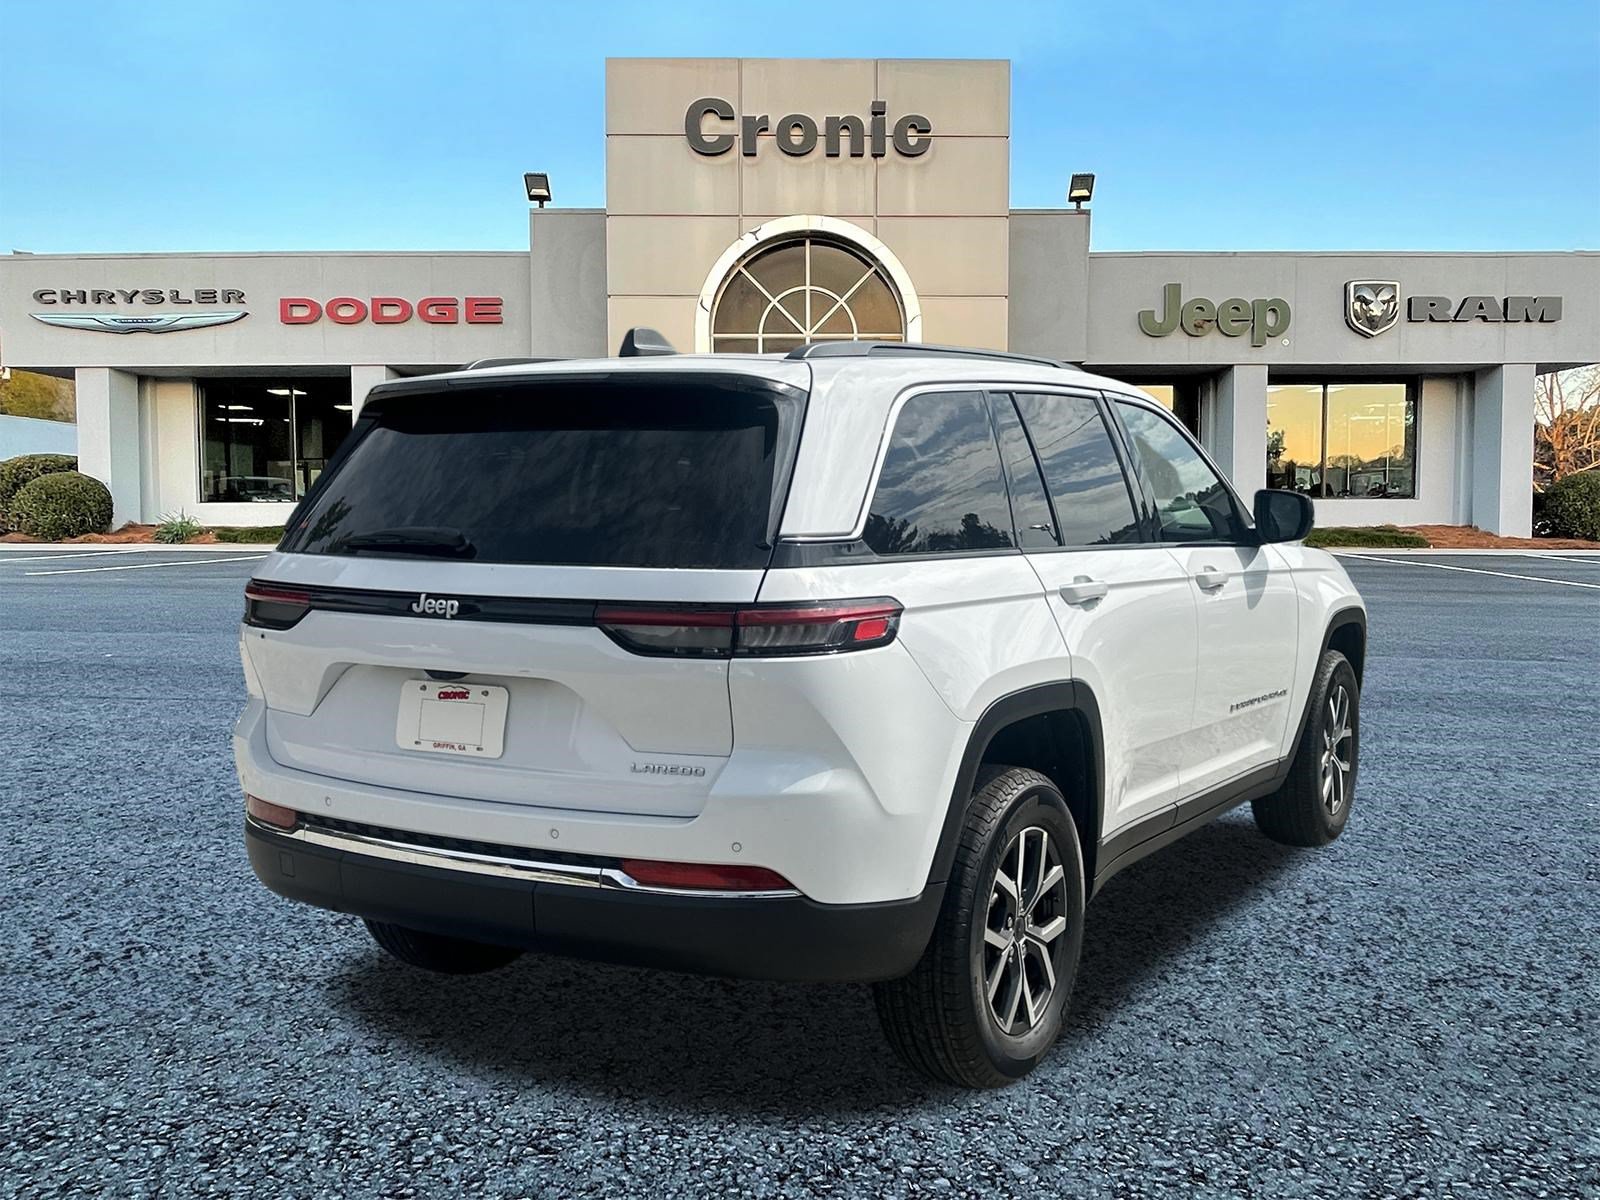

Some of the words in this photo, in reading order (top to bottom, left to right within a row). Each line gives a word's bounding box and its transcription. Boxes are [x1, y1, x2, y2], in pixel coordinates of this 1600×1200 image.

[685, 97, 932, 157] Cronic
[32, 288, 246, 305] CHRYSLER
[279, 297, 503, 324] DODGE
[1138, 283, 1291, 347] Jeep
[1407, 296, 1562, 323] RAM
[412, 593, 459, 618] Jeep
[438, 690, 470, 700] CRONIC
[433, 742, 457, 751] GRIFFIN,
[629, 762, 706, 777] LAREDO
